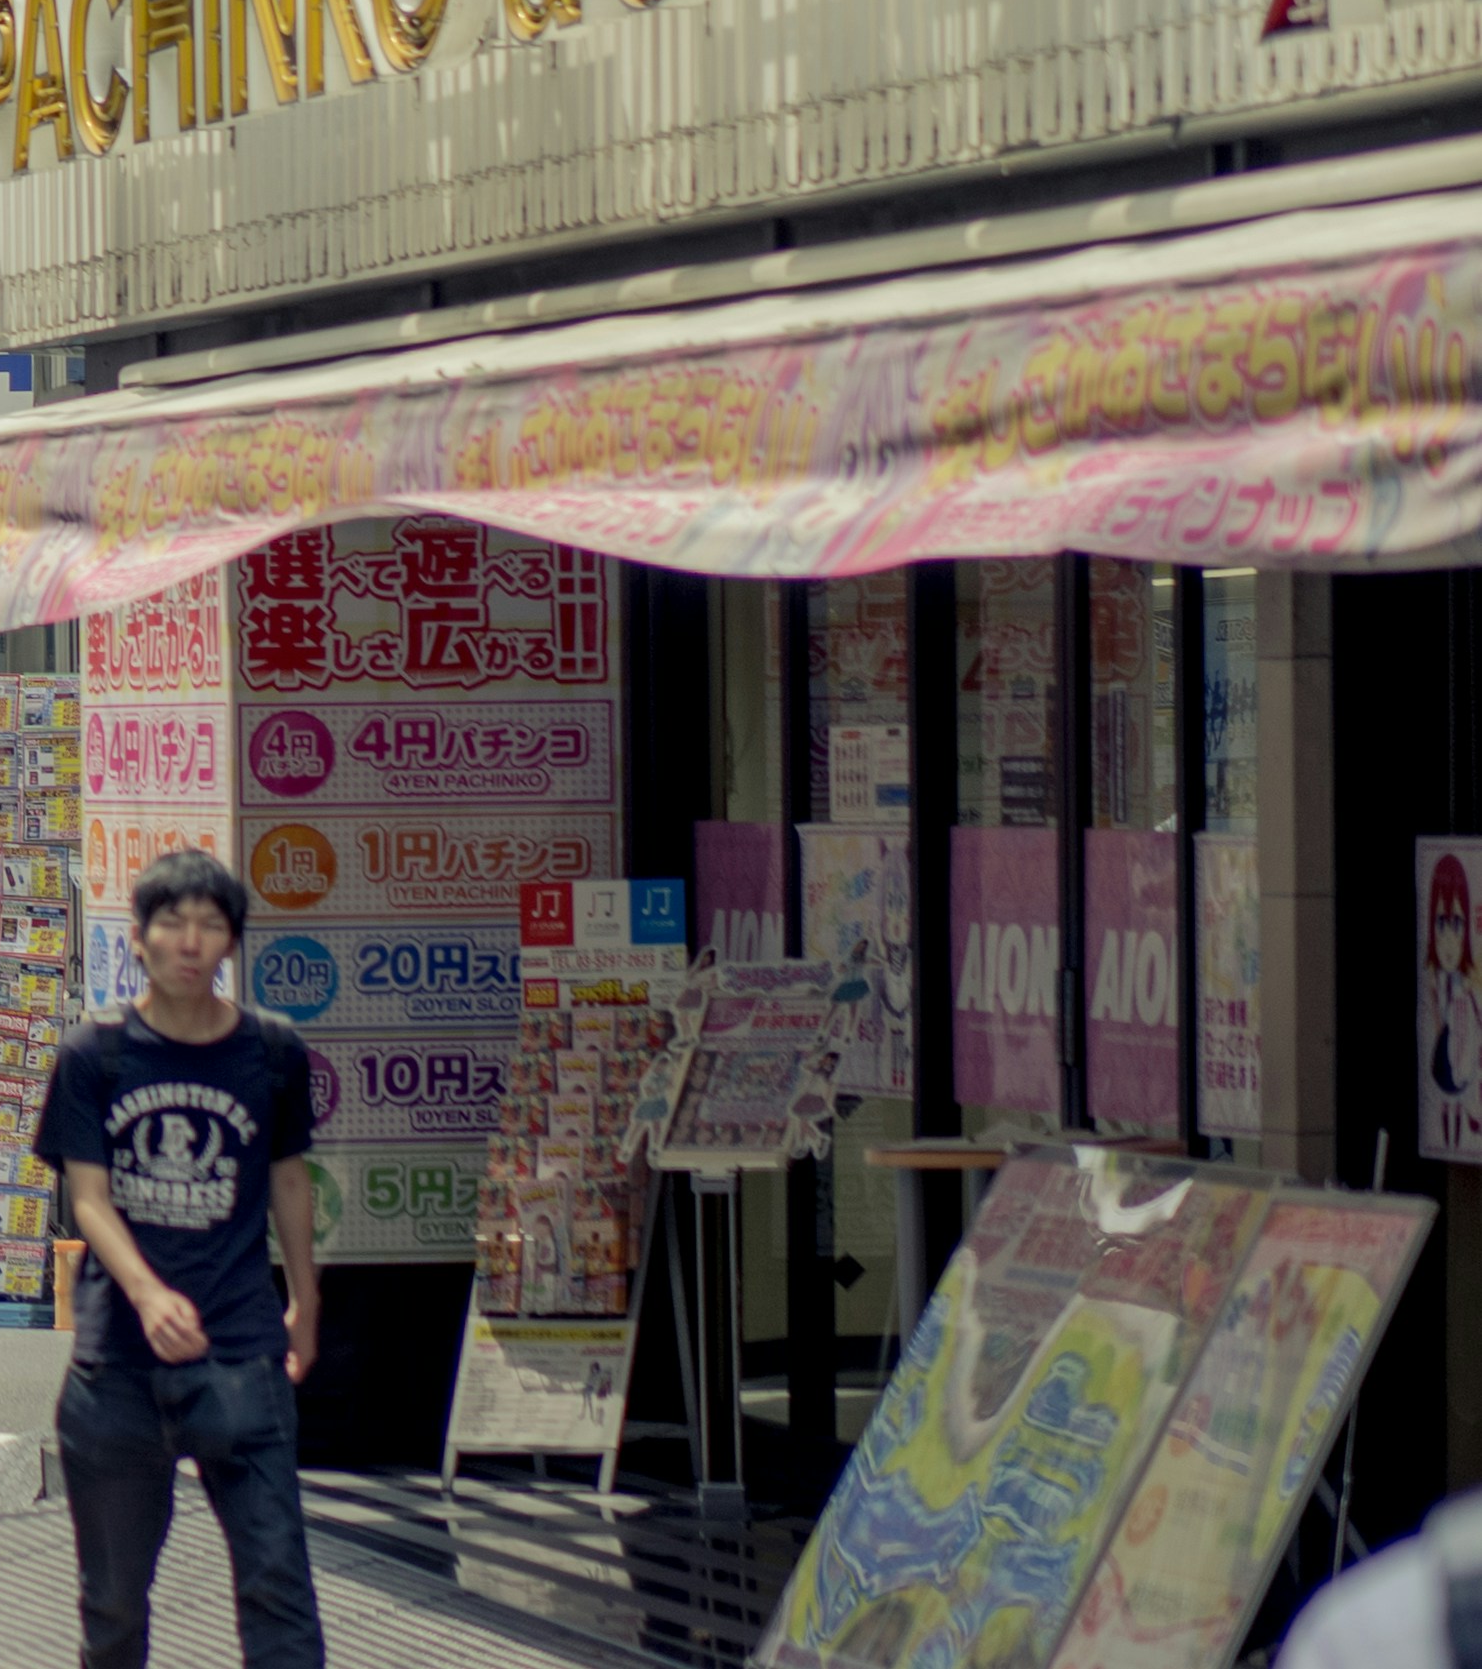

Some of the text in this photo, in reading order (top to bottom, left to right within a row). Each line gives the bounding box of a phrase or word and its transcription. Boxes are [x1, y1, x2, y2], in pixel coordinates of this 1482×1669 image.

[246, 600, 608, 688] 楽しさ広がる!!
[268, 725, 316, 757] 4円
[349, 714, 589, 774] 4円パチンコ
[443, 771, 545, 791] PACHINKO
[272, 840, 315, 871] 1円
[359, 826, 590, 884] 1円パチンコ
[443, 883, 520, 903] PACHIN
[262, 950, 330, 988] 20円
[356, 1052, 506, 1106] 10円ス
[473, 1109, 497, 1127] SL
